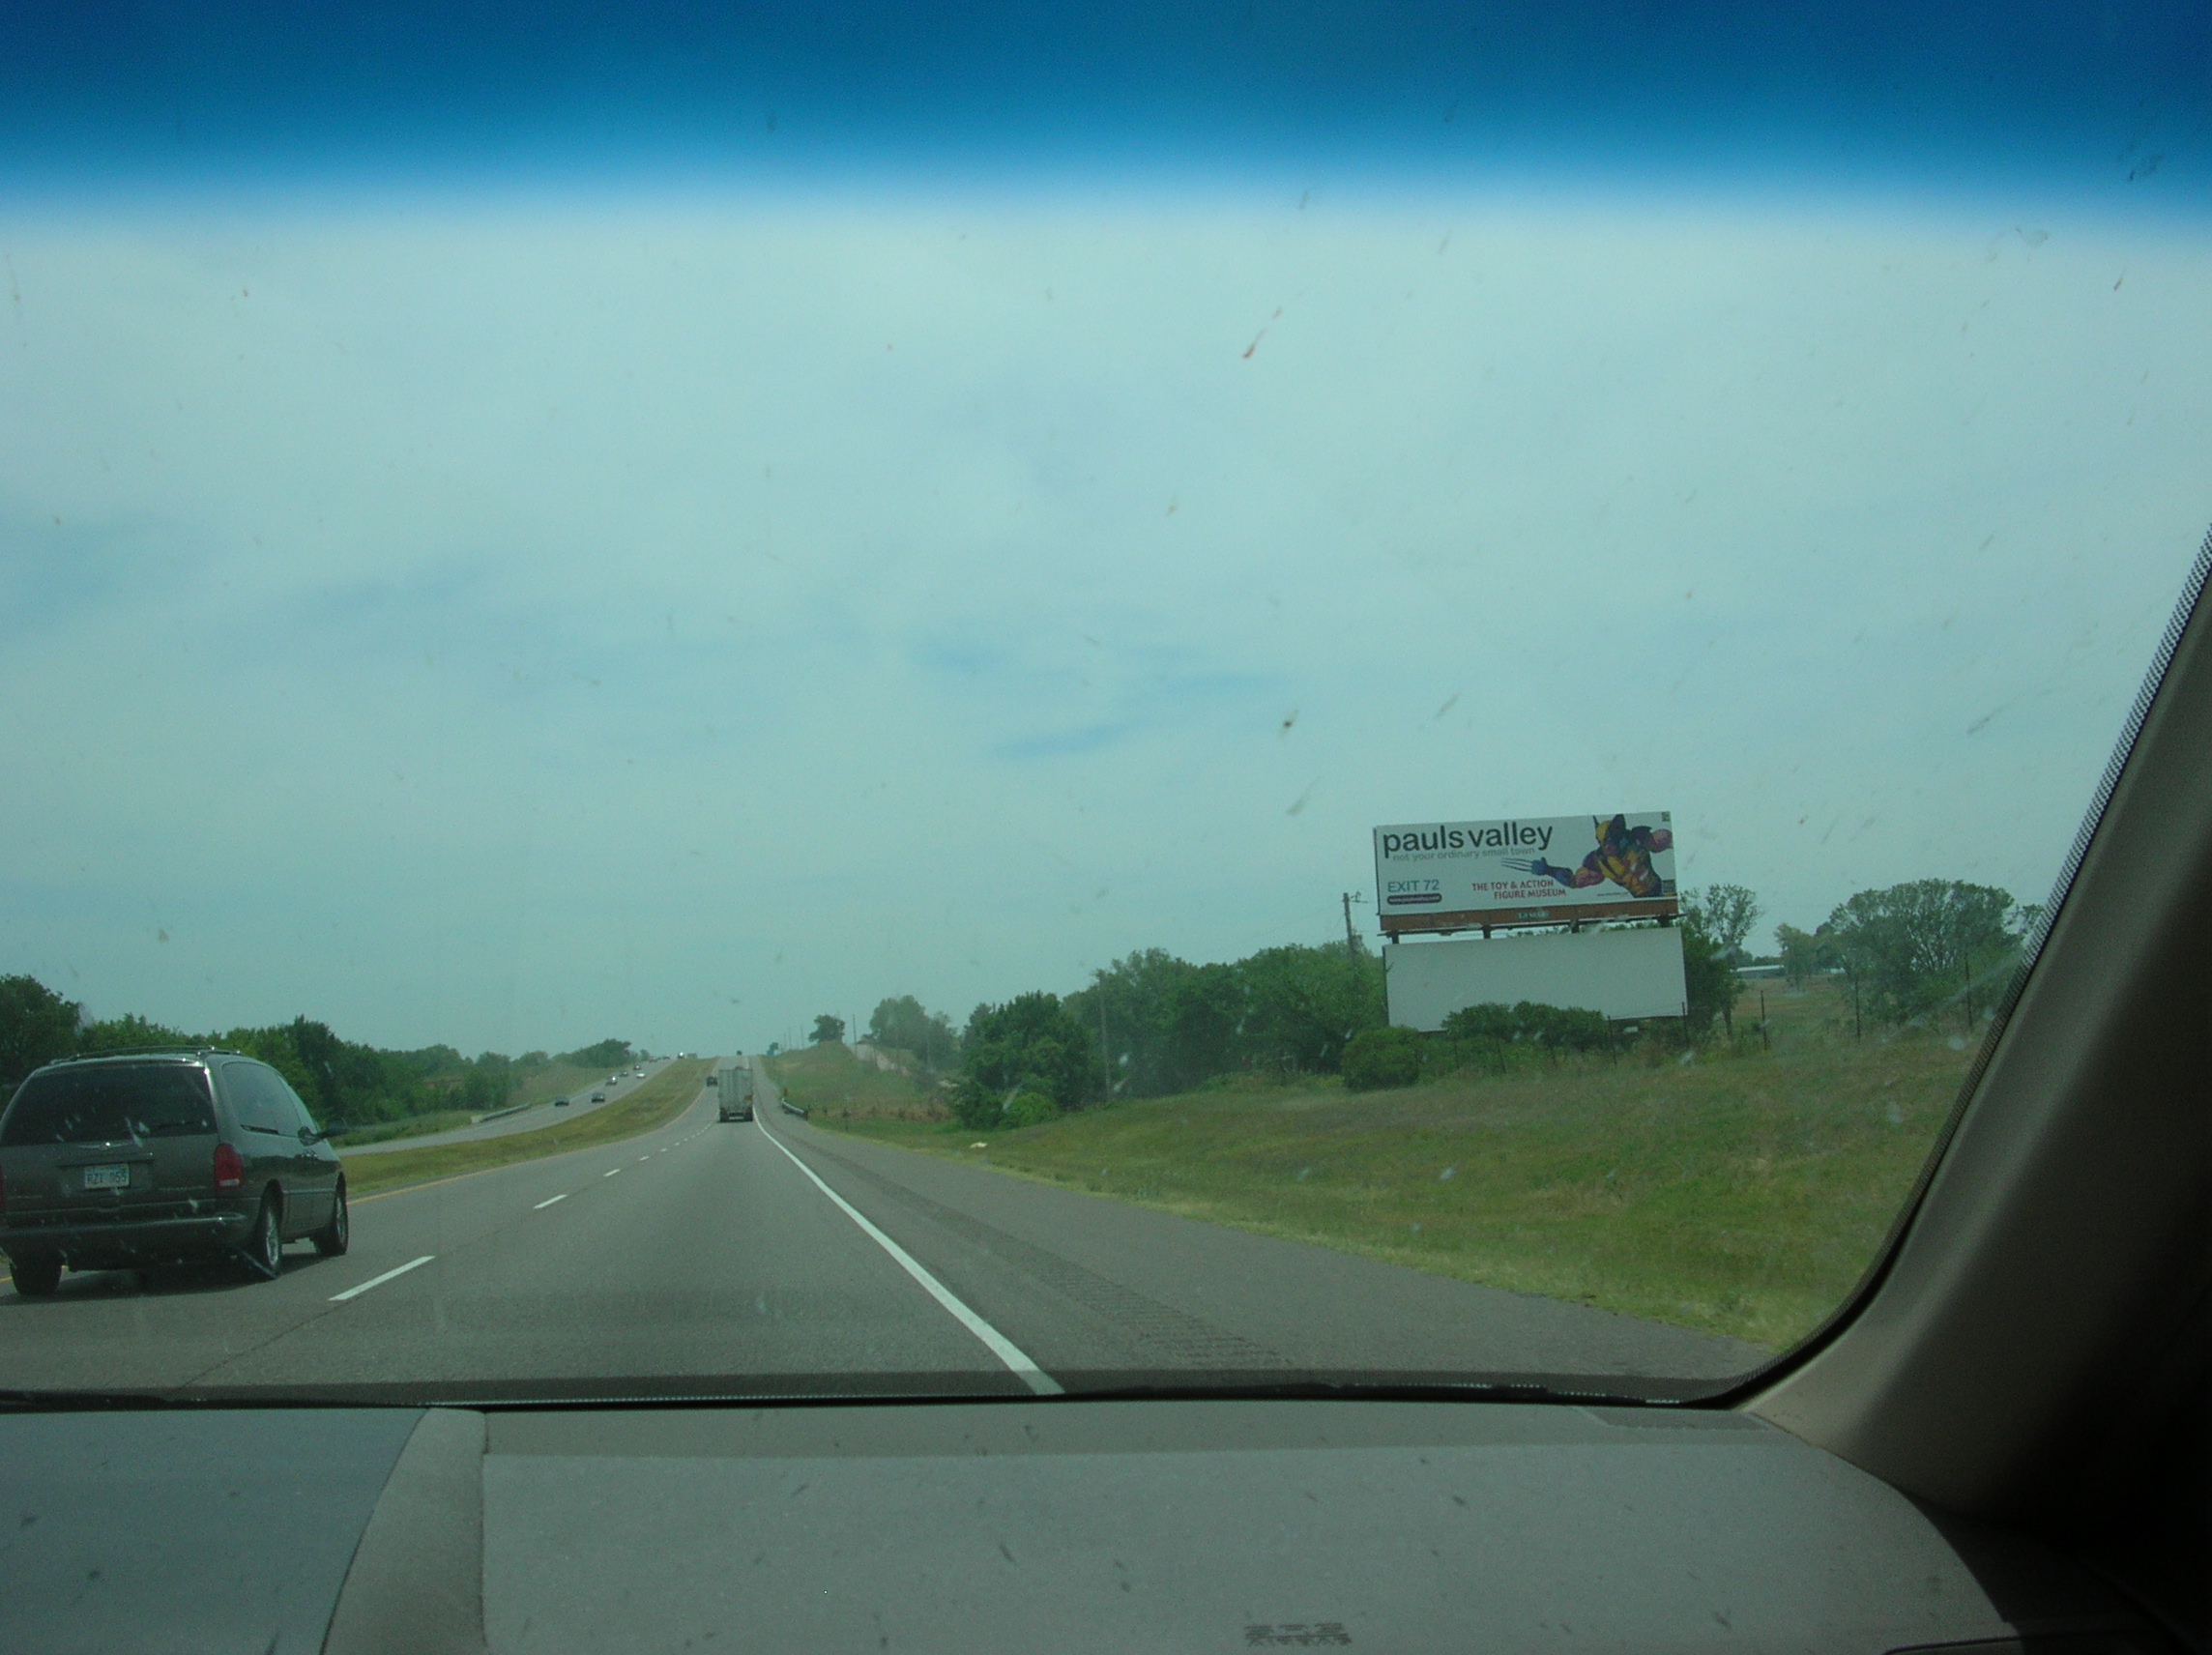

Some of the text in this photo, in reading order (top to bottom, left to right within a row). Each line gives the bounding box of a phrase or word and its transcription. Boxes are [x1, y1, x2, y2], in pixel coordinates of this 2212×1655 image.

[1392, 847, 1536, 862] not your ordinary small town
[1387, 879, 1441, 893] EXIT 72
[1471, 879, 1555, 891] THE TOY & ACTION
[1494, 887, 1567, 900] FIGURE MUSEUM
